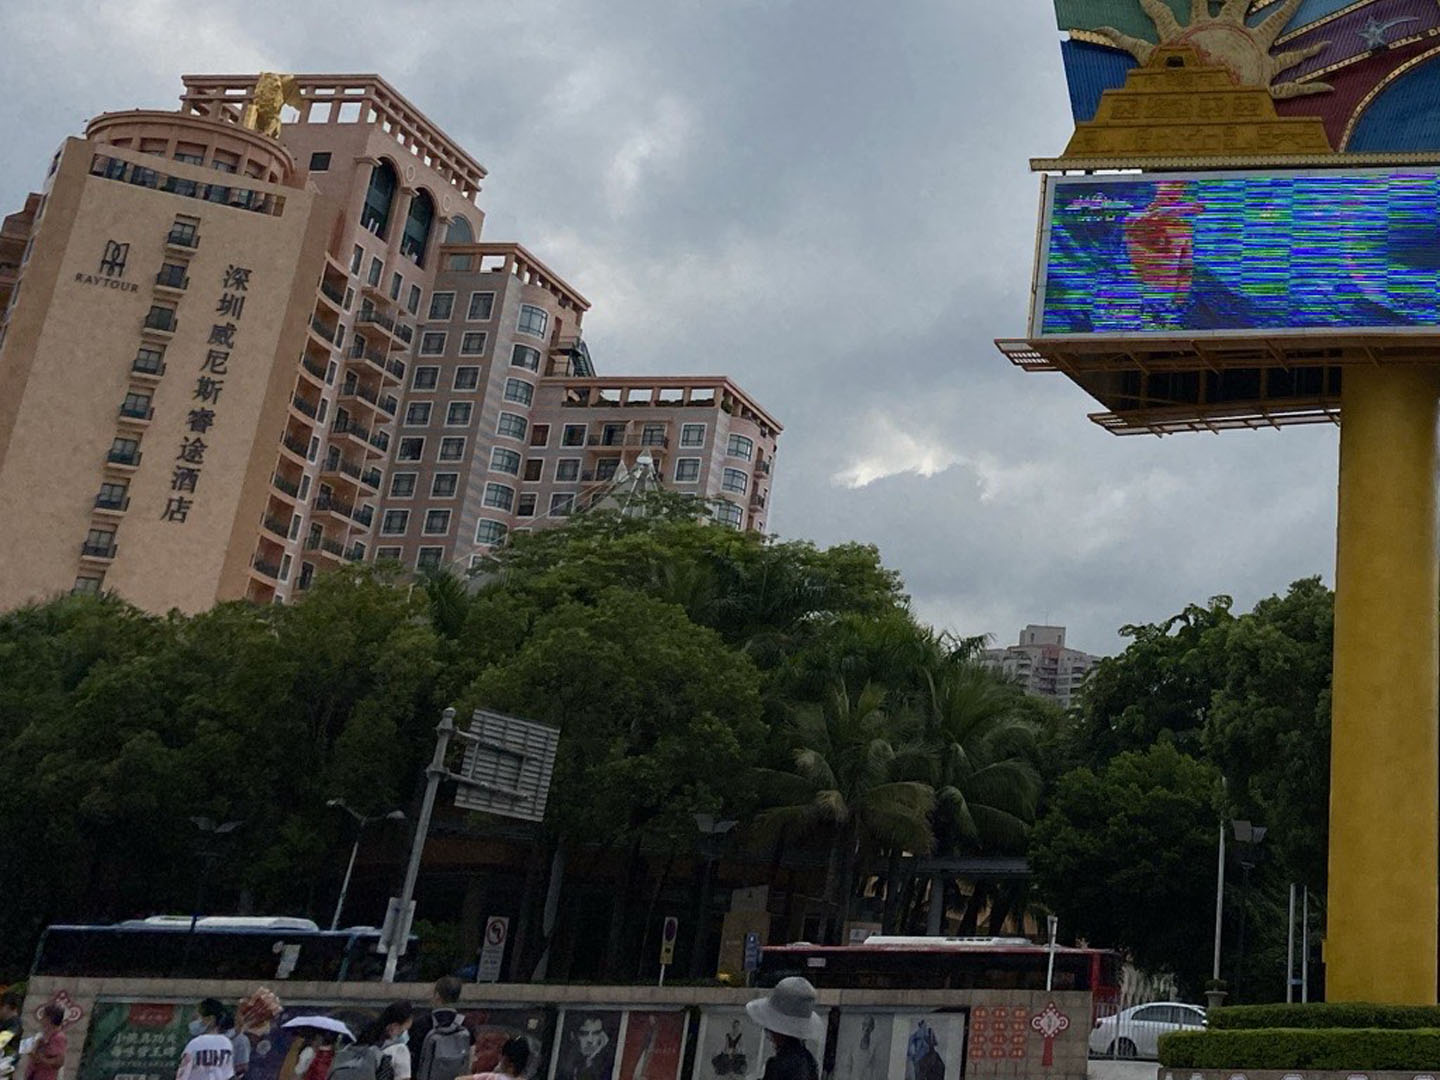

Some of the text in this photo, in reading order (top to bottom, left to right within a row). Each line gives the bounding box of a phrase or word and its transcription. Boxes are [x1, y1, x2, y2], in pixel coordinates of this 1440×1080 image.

[74, 272, 139, 293] RAYTOUR
[161, 264, 252, 524] 深圳威尼斯睿途酒店
